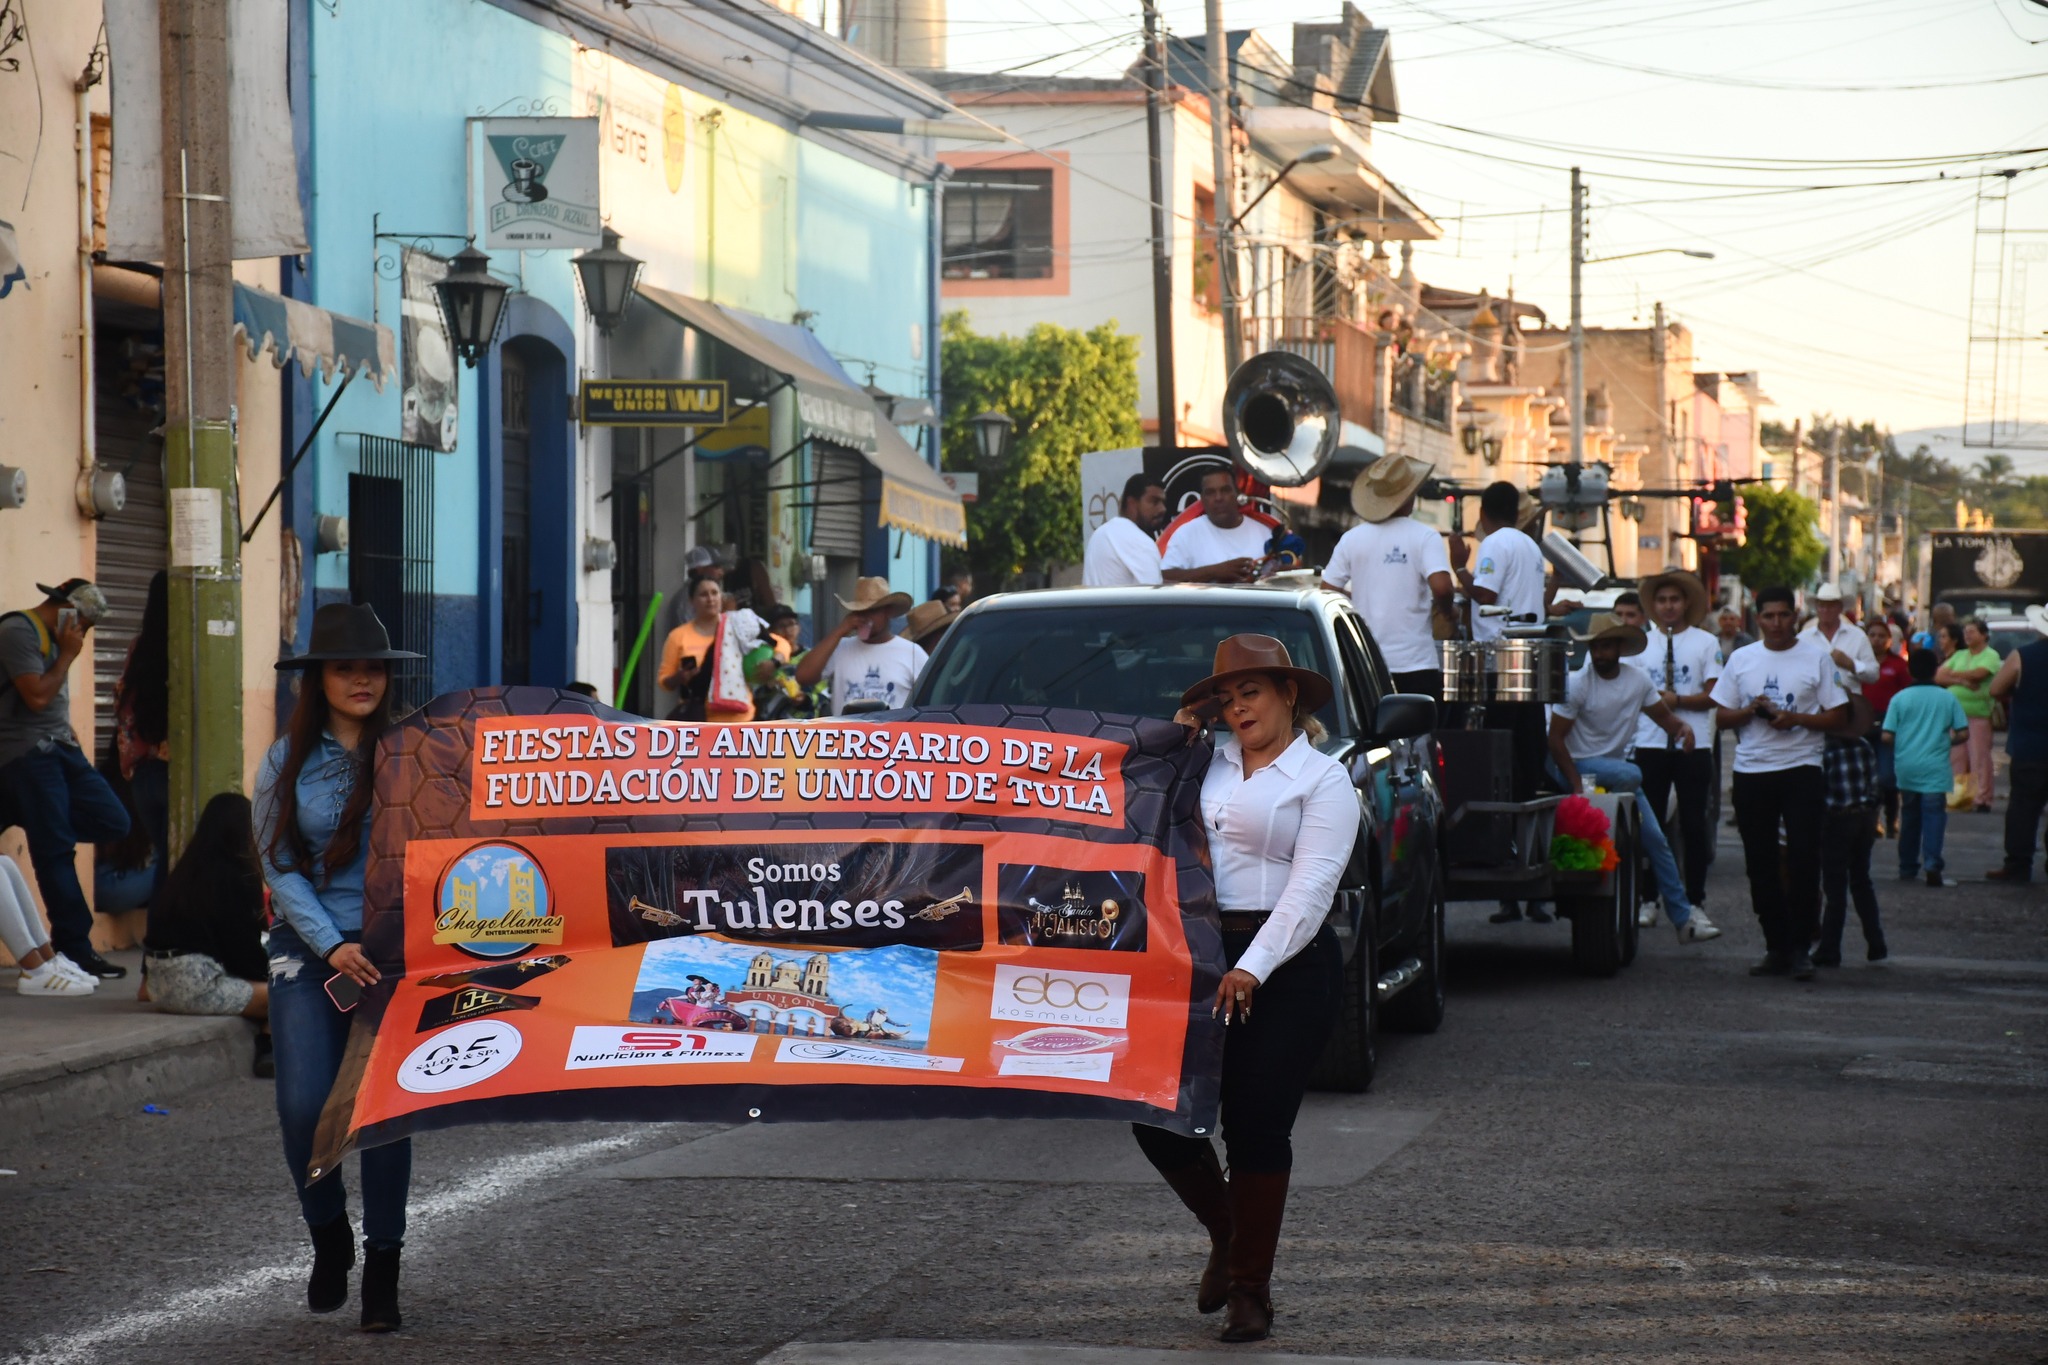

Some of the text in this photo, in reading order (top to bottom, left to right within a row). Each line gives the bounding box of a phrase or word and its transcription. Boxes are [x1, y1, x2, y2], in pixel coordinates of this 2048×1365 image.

[495, 207, 510, 225] EL
[562, 208, 591, 228] AZUL
[589, 388, 666, 400] WESTERN
[675, 388, 721, 412] WU
[613, 400, 667, 412] UNION
[1934, 537, 1953, 548] LA
[481, 725, 1107, 782] FIESTAS DE ANIVERSARIO DE LA
[485, 757, 1113, 815] FUNDACIÓN DE UNIÓN DE TULA
[747, 858, 842, 884] Somos
[683, 886, 906, 932] Tulenses
[1057, 902, 1094, 918] Banda
[437, 907, 563, 938] Chagollamas
[485, 929, 540, 937] ENTERTAINMENT
[997, 1006, 1120, 1026] kosmetics
[415, 1048, 501, 1072] SALÓN & SPA
[574, 1050, 656, 1063] Nutrición
[678, 1049, 745, 1058] Fitness
